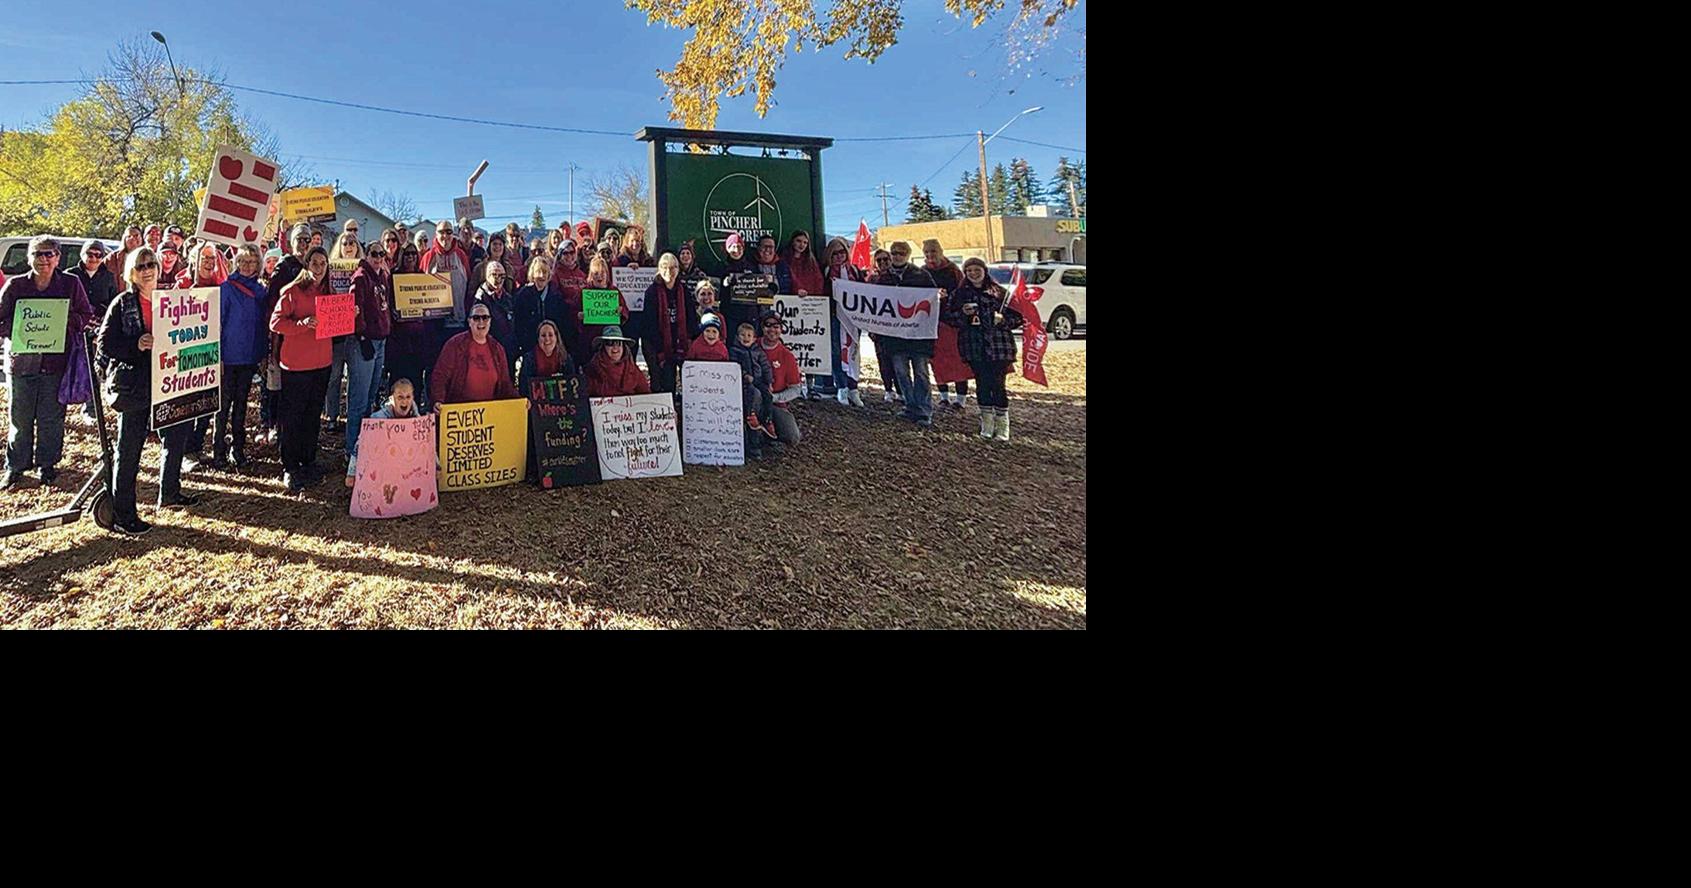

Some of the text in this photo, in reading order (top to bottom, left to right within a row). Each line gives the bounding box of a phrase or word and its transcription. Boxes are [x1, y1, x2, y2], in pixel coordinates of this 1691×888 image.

[710, 216, 758, 229] PINCHER
[585, 291, 619, 300] SUPPORT
[160, 295, 208, 326] Fighting
[776, 300, 799, 318] Our
[842, 291, 896, 318] UNA
[22, 307, 51, 320] Public
[851, 315, 870, 324] United
[871, 319, 892, 328] Nurses
[168, 324, 208, 344] TODAY
[780, 319, 826, 336] Students
[780, 337, 815, 351] serve
[160, 352, 177, 370] For
[796, 352, 822, 368] tter
[161, 367, 216, 394] Students
[446, 408, 485, 428] EVERY
[557, 417, 573, 430] the
[602, 411, 610, 424] I
[614, 410, 632, 422] miss
[636, 410, 648, 425] my
[386, 423, 406, 440] you
[446, 426, 494, 446] STUDENT
[638, 422, 646, 434] I
[545, 427, 588, 448] funding?
[621, 438, 636, 448] way
[636, 436, 648, 446] too
[650, 432, 669, 444] much
[446, 442, 494, 462] DESERVES
[446, 456, 492, 474] LIMITED
[446, 468, 517, 488] CLASS SIZES
